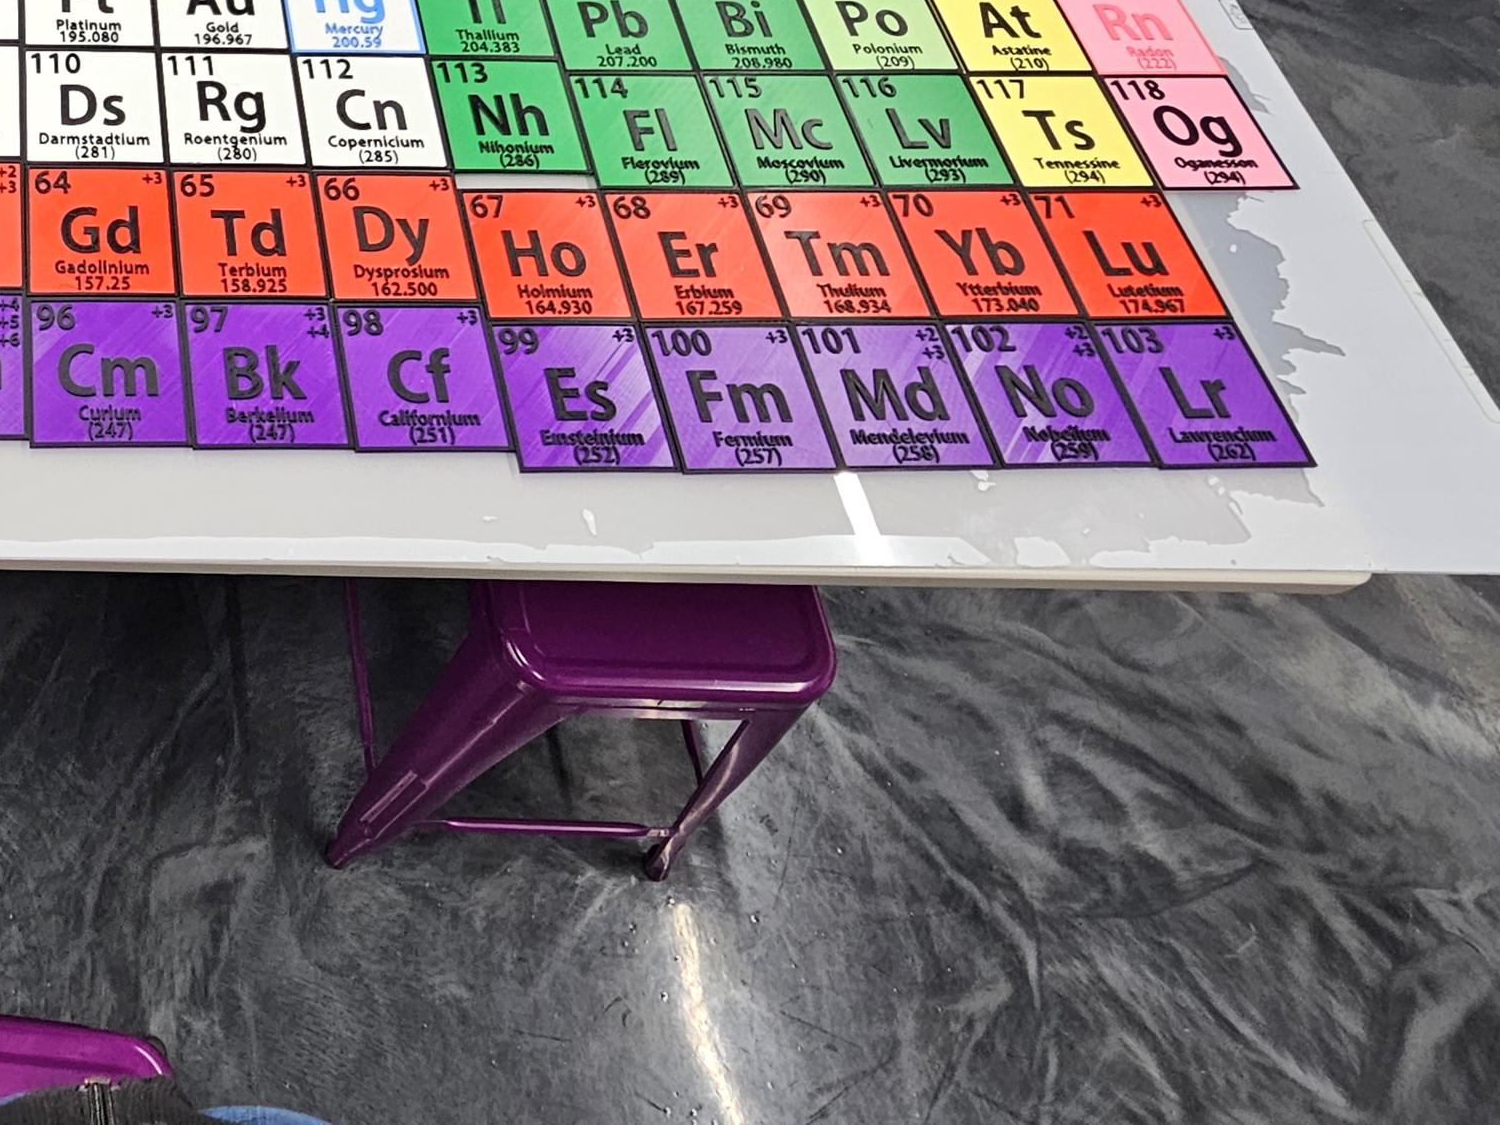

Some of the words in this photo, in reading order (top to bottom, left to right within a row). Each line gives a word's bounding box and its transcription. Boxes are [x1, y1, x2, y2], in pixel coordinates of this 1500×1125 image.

[56, 19, 122, 31] Platinum
[206, 21, 239, 33] Gold
[577, 0, 649, 38] Pb
[979, 2, 1042, 39] At
[1092, 3, 1174, 41] Rn
[60, 30, 119, 43] 195.080
[194, 33, 252, 45] 196.967
[455, 29, 520, 41] Thallium
[460, 40, 520, 53] 204.383
[605, 43, 642, 55] Lead
[992, 45, 1052, 56] Astatine
[31, 53, 81, 74] 110
[302, 58, 353, 79] 112
[597, 56, 657, 67] 207.200
[976, 79, 1024, 99] 117
[1110, 80, 1165, 100] 118
[60, 84, 126, 126] Ds
[336, 89, 408, 131] Cn
[1021, 110, 1095, 150] Ts
[1153, 105, 1243, 158] Og
[39, 132, 150, 145] Darmstadtium
[328, 135, 425, 151] Copernicium
[75, 145, 115, 160] (281)
[359, 150, 399, 164] (285)
[1033, 157, 1120, 169] Tennessine
[35, 171, 71, 194] 64
[1064, 170, 1106, 184] (294)
[470, 194, 503, 219] 67
[61, 205, 141, 254] Gd
[500, 230, 586, 277] Ho
[55, 259, 150, 275] Gadolinium
[75, 276, 130, 290] 157.25
[517, 284, 593, 299] Holmium
[525, 300, 592, 315] 164.930
[1101, 327, 1165, 354] 103
[685, 370, 793, 423] Fm
[1158, 367, 1232, 420] Lr
